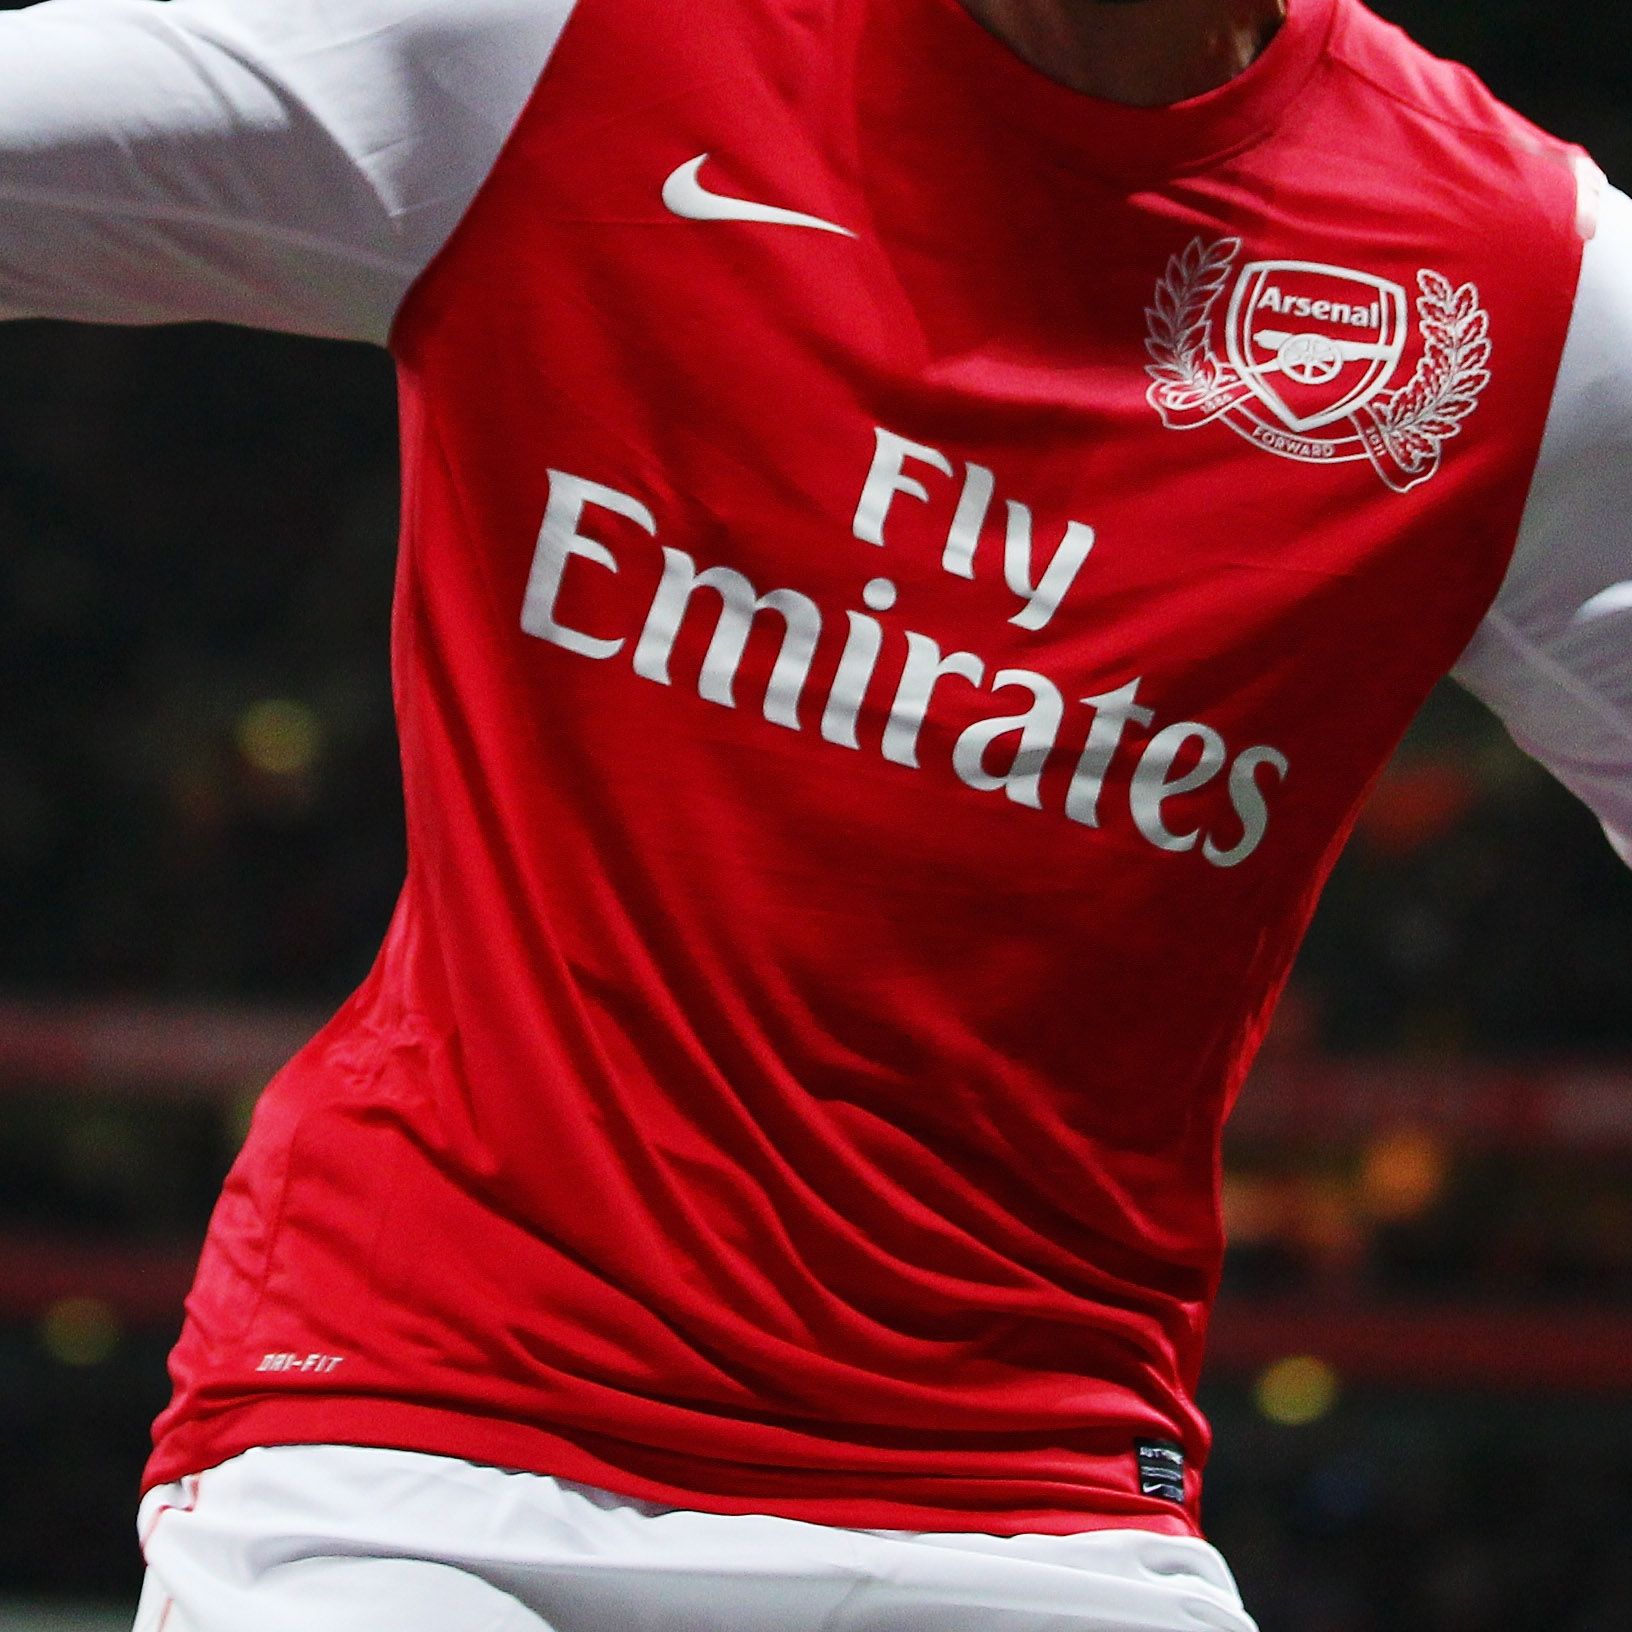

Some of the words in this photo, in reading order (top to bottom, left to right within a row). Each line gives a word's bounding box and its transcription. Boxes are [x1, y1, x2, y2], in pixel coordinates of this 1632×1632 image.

[1257, 286, 1379, 329] Arsenal
[1252, 426, 1335, 457] FORWARD
[852, 426, 1096, 632] Fly
[520, 467, 1289, 868] Emirates
